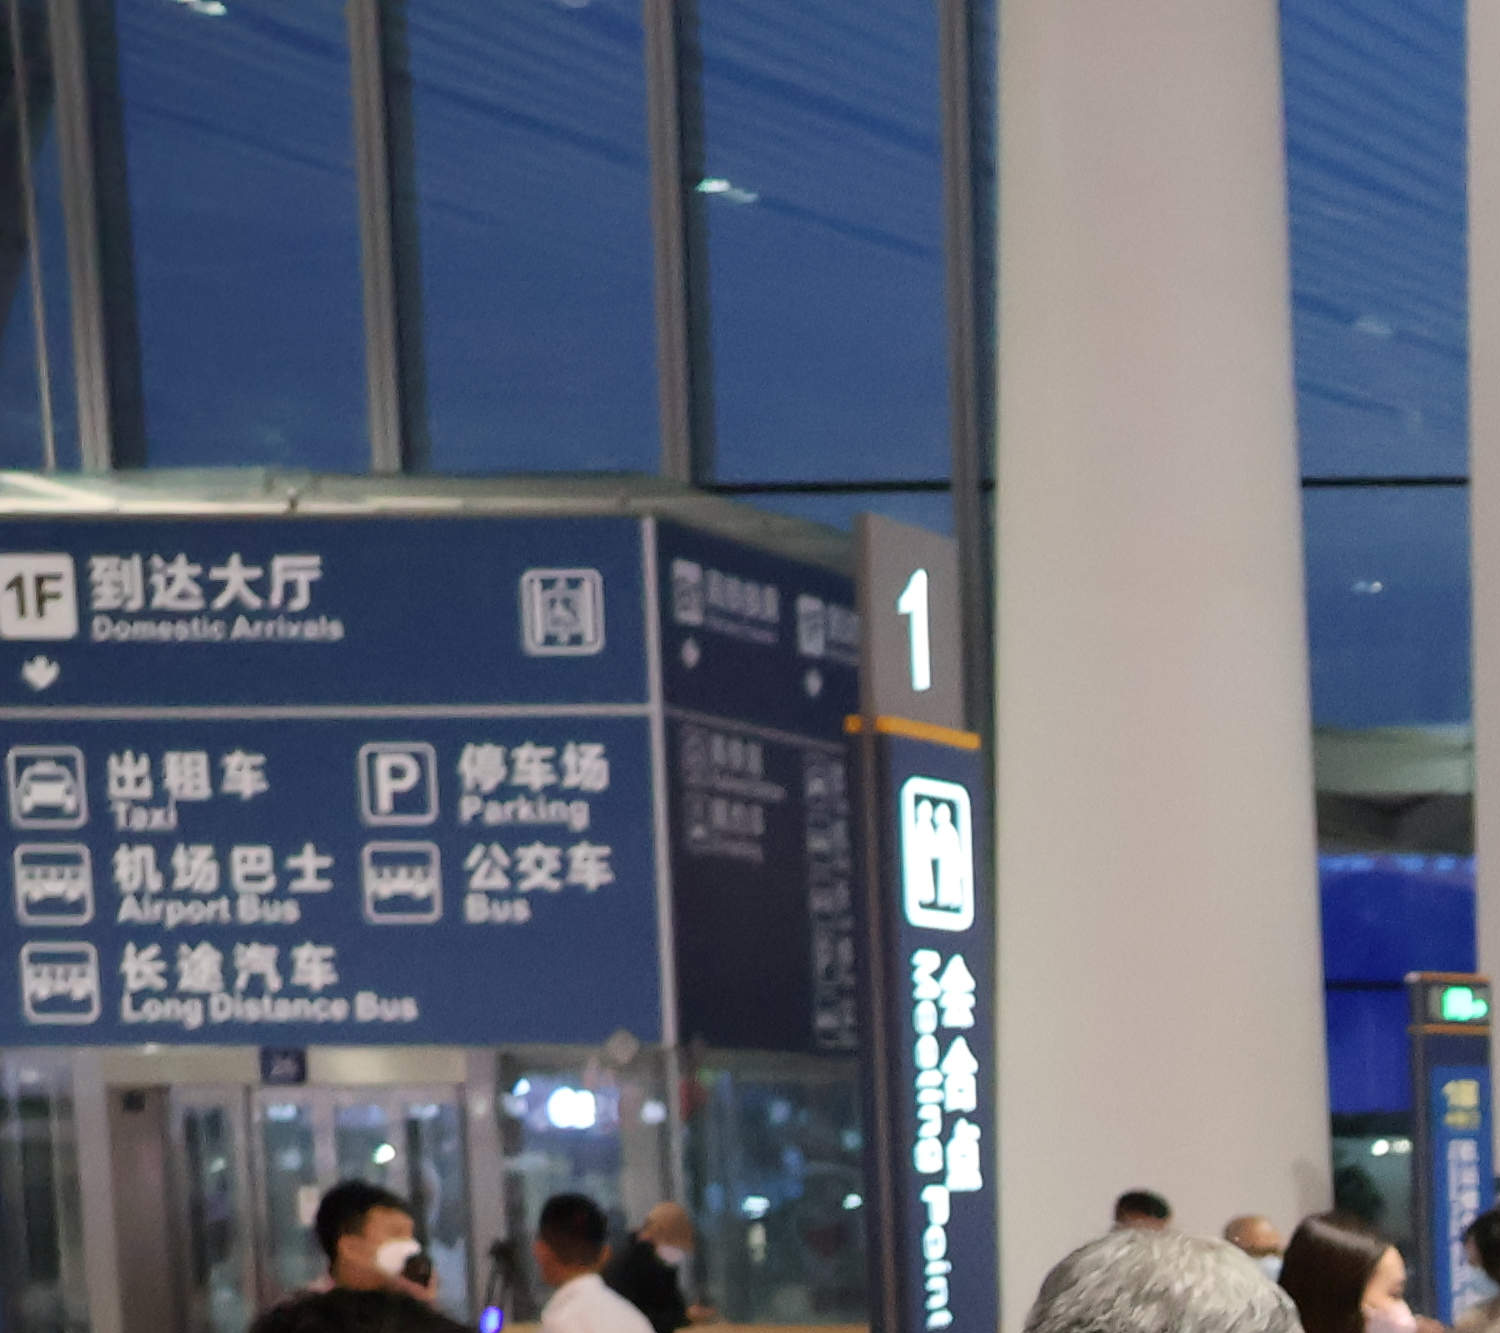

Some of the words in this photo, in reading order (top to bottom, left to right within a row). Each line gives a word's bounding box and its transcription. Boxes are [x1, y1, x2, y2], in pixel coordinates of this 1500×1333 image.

[5, 572, 64, 620] 1F
[89, 553, 322, 612] 到达大厅
[92, 615, 225, 642] Domestic
[232, 614, 345, 641] Arrivals
[897, 568, 932, 691] 1
[107, 749, 269, 803] 出租车
[458, 742, 610, 794] 停车场
[111, 802, 178, 831] Taxi
[459, 796, 590, 832] Parking
[113, 843, 334, 896] 机场巴士
[464, 842, 614, 893] 公交车
[117, 896, 231, 931] Airport
[237, 896, 301, 924] Bus
[464, 895, 531, 923] Bus
[120, 942, 338, 994] 长途汽车
[121, 993, 204, 1029] Long
[210, 993, 350, 1023] Distance
[356, 993, 419, 1023] Bus
[911, 949, 945, 1174] Meeting
[939, 953, 983, 1193] 会合点
[921, 1184, 955, 1331] Point
